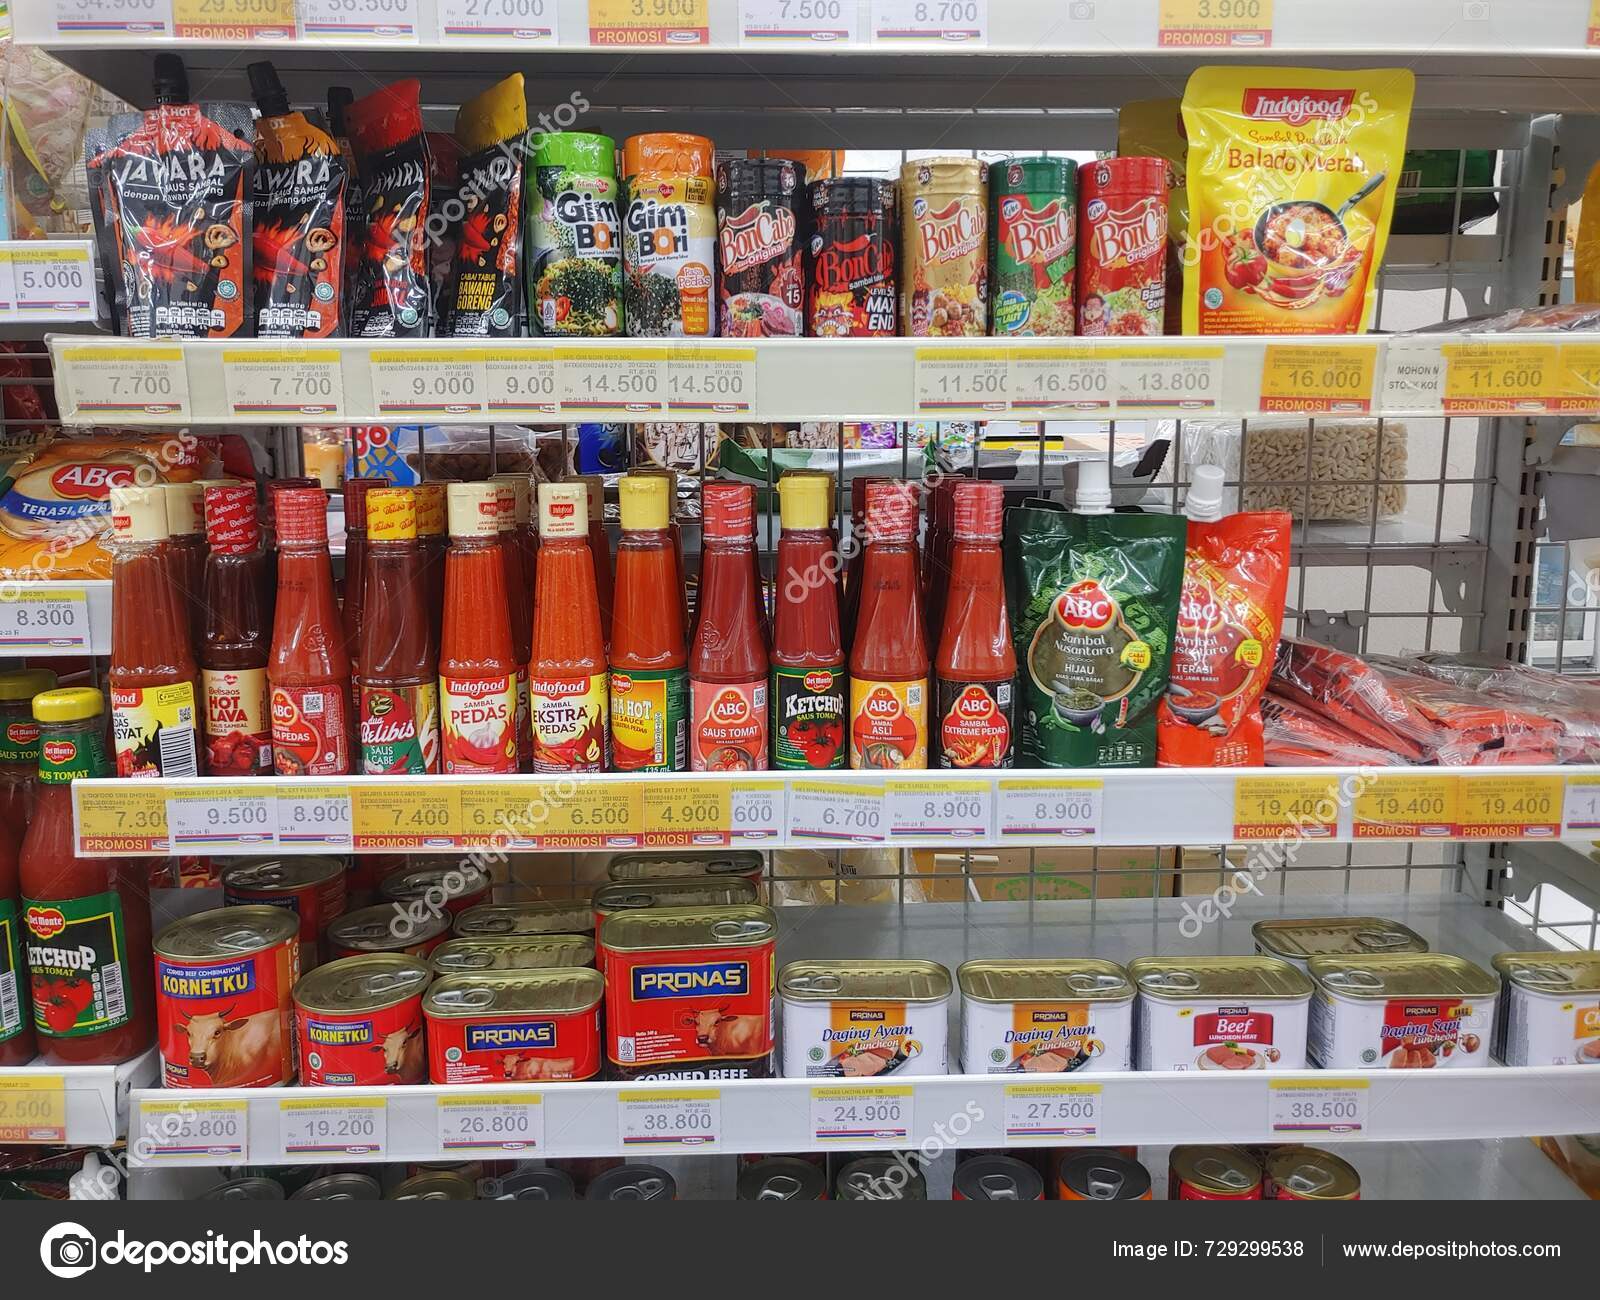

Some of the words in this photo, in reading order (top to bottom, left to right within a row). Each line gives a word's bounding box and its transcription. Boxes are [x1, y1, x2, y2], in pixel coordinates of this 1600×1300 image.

[466, 0, 544, 16] 27.000
[631, 0, 695, 16] 3.900
[778, 0, 840, 19] 7.500
[914, 2, 978, 22] 8.700
[1198, 0, 1260, 18] 3.900
[182, 27, 249, 40] PROMOSI
[597, 31, 662, 43] PROMOSI
[1164, 32, 1227, 45] PROMOSI
[1253, 96, 1344, 121] Indofood
[1249, 130, 1291, 143] Sambal
[1229, 148, 1296, 171] Balado
[123, 190, 160, 201] dengan
[294, 184, 327, 195] SAMBAL
[557, 192, 618, 223] Gim
[628, 201, 687, 231] Gim
[720, 210, 795, 271] BonCabe
[748, 242, 785, 265] Original
[684, 267, 703, 276] Rasa
[23, 271, 83, 288] 5.000
[679, 276, 711, 288] Pedas
[850, 277, 873, 290] sambal
[459, 282, 495, 295] BAWANG
[457, 295, 493, 309] GORENG
[786, 289, 800, 304] 15
[866, 297, 895, 314] MAX
[868, 315, 895, 330] END
[1397, 366, 1432, 374] MOHON
[108, 377, 171, 394] 7.700
[269, 378, 332, 395] 7.700
[413, 377, 475, 395] 9.000
[582, 374, 657, 393] 14.500
[669, 375, 743, 393] 14.500
[1034, 374, 1107, 391] 16.500
[1138, 373, 1210, 390] 13.800
[1289, 370, 1362, 388] 16.000
[1470, 370, 1543, 388] 11.600
[1266, 399, 1327, 411] PROMOSI
[1450, 400, 1512, 411] PROMOSI
[57, 467, 131, 488] ABC
[22, 501, 74, 517] TERASI
[1063, 598, 1109, 620] ABC
[16, 610, 75, 626] 8.300
[1061, 631, 1106, 646] Sambal
[1055, 640, 1115, 656] Nusantara
[1064, 663, 1095, 674] HIJAU
[1176, 664, 1213, 674] TERASI
[208, 686, 240, 695] Delisaos
[450, 679, 505, 695] Indofood
[532, 679, 585, 696] Indofood
[209, 696, 240, 709] HOT
[463, 699, 495, 709] SAMBAL
[542, 701, 572, 709] SAMBAL
[627, 699, 652, 720] HOT
[716, 702, 745, 716] ABC
[785, 694, 844, 718] KETCHUP
[869, 700, 897, 712] ABC
[961, 699, 989, 712] ABC
[209, 709, 249, 722] LAVA
[273, 704, 291, 718] ABC
[451, 705, 507, 724] PEDAS
[533, 708, 588, 724] EKSTRA
[797, 713, 815, 721] SAUS
[816, 711, 836, 721] TOMAT
[367, 715, 385, 724] dua
[620, 716, 645, 726] SAUCE
[871, 719, 893, 727] SAMBAL
[959, 719, 990, 728] SAMBAL
[361, 719, 416, 744] Belibis
[539, 722, 577, 734] PEDAS
[702, 727, 727, 738] SAUS
[729, 725, 758, 737] TOMAT
[872, 726, 893, 736] ASLI
[944, 726, 980, 737] EXTREME
[981, 725, 1007, 735] PEDAS
[281, 732, 310, 741] PEDAS
[54, 747, 74, 755] Monte
[371, 746, 394, 755] SAUS
[372, 755, 395, 765] CABE
[53, 770, 89, 780] TOMAT
[924, 801, 982, 819] 8.900
[1035, 803, 1092, 820] 8.900
[1257, 799, 1328, 816] 19.400
[1375, 797, 1445, 815] 19.400
[1481, 797, 1550, 815] 19.400
[207, 807, 267, 825] 9.500
[391, 809, 449, 826] 7.400
[571, 808, 629, 825] 6.500
[661, 806, 720, 823] 4.900
[822, 808, 880, 828] 6.700
[1239, 827, 1297, 837] PROMOSI
[1359, 826, 1417, 836] PROMOSI
[1463, 826, 1520, 837] PROMOSI
[86, 839, 147, 850] PROMOSI
[359, 838, 419, 848] PROMOSI
[544, 837, 602, 847] PROMOSI
[38, 916, 62, 926] Monte
[45, 967, 75, 977] TOMAT
[166, 967, 184, 976] CORNED
[185, 967, 198, 976] BEEF
[198, 965, 241, 976] COMBINATION
[162, 972, 249, 996] KORNETKU
[640, 969, 743, 991] PRONAS
[850, 1011, 884, 1020] PRONAS
[1033, 1012, 1067, 1021] PRONAS
[1219, 1007, 1248, 1016] PRONAS
[1405, 1007, 1437, 1016] PRONAS
[822, 1027, 872, 1043] Daging
[874, 1024, 913, 1038] Ayam
[1216, 1018, 1254, 1034] Beef
[1380, 1022, 1427, 1039] Daging
[1432, 1019, 1461, 1035] Sapi
[309, 1028, 369, 1043] KORNETKU
[471, 1026, 552, 1044] PRONAS
[1004, 1029, 1052, 1044] Daging
[1056, 1025, 1096, 1039] Ayam
[1208, 1033, 1240, 1042] LUNCHEON
[1241, 1033, 1258, 1041] MEAT
[1413, 1032, 1457, 1045] Luncheon
[854, 1038, 900, 1052] Luncheon
[1036, 1038, 1083, 1052] Luncheon
[325, 1075, 353, 1083] PRONAS
[709, 1068, 748, 1080] BEEF
[834, 1105, 901, 1122] 24.900
[1028, 1102, 1094, 1120] 27.500
[1291, 1101, 1358, 1119] 38.500
[305, 1120, 374, 1136] 19.200
[460, 1116, 529, 1133] 26.800
[644, 1113, 712, 1130] 38.800
